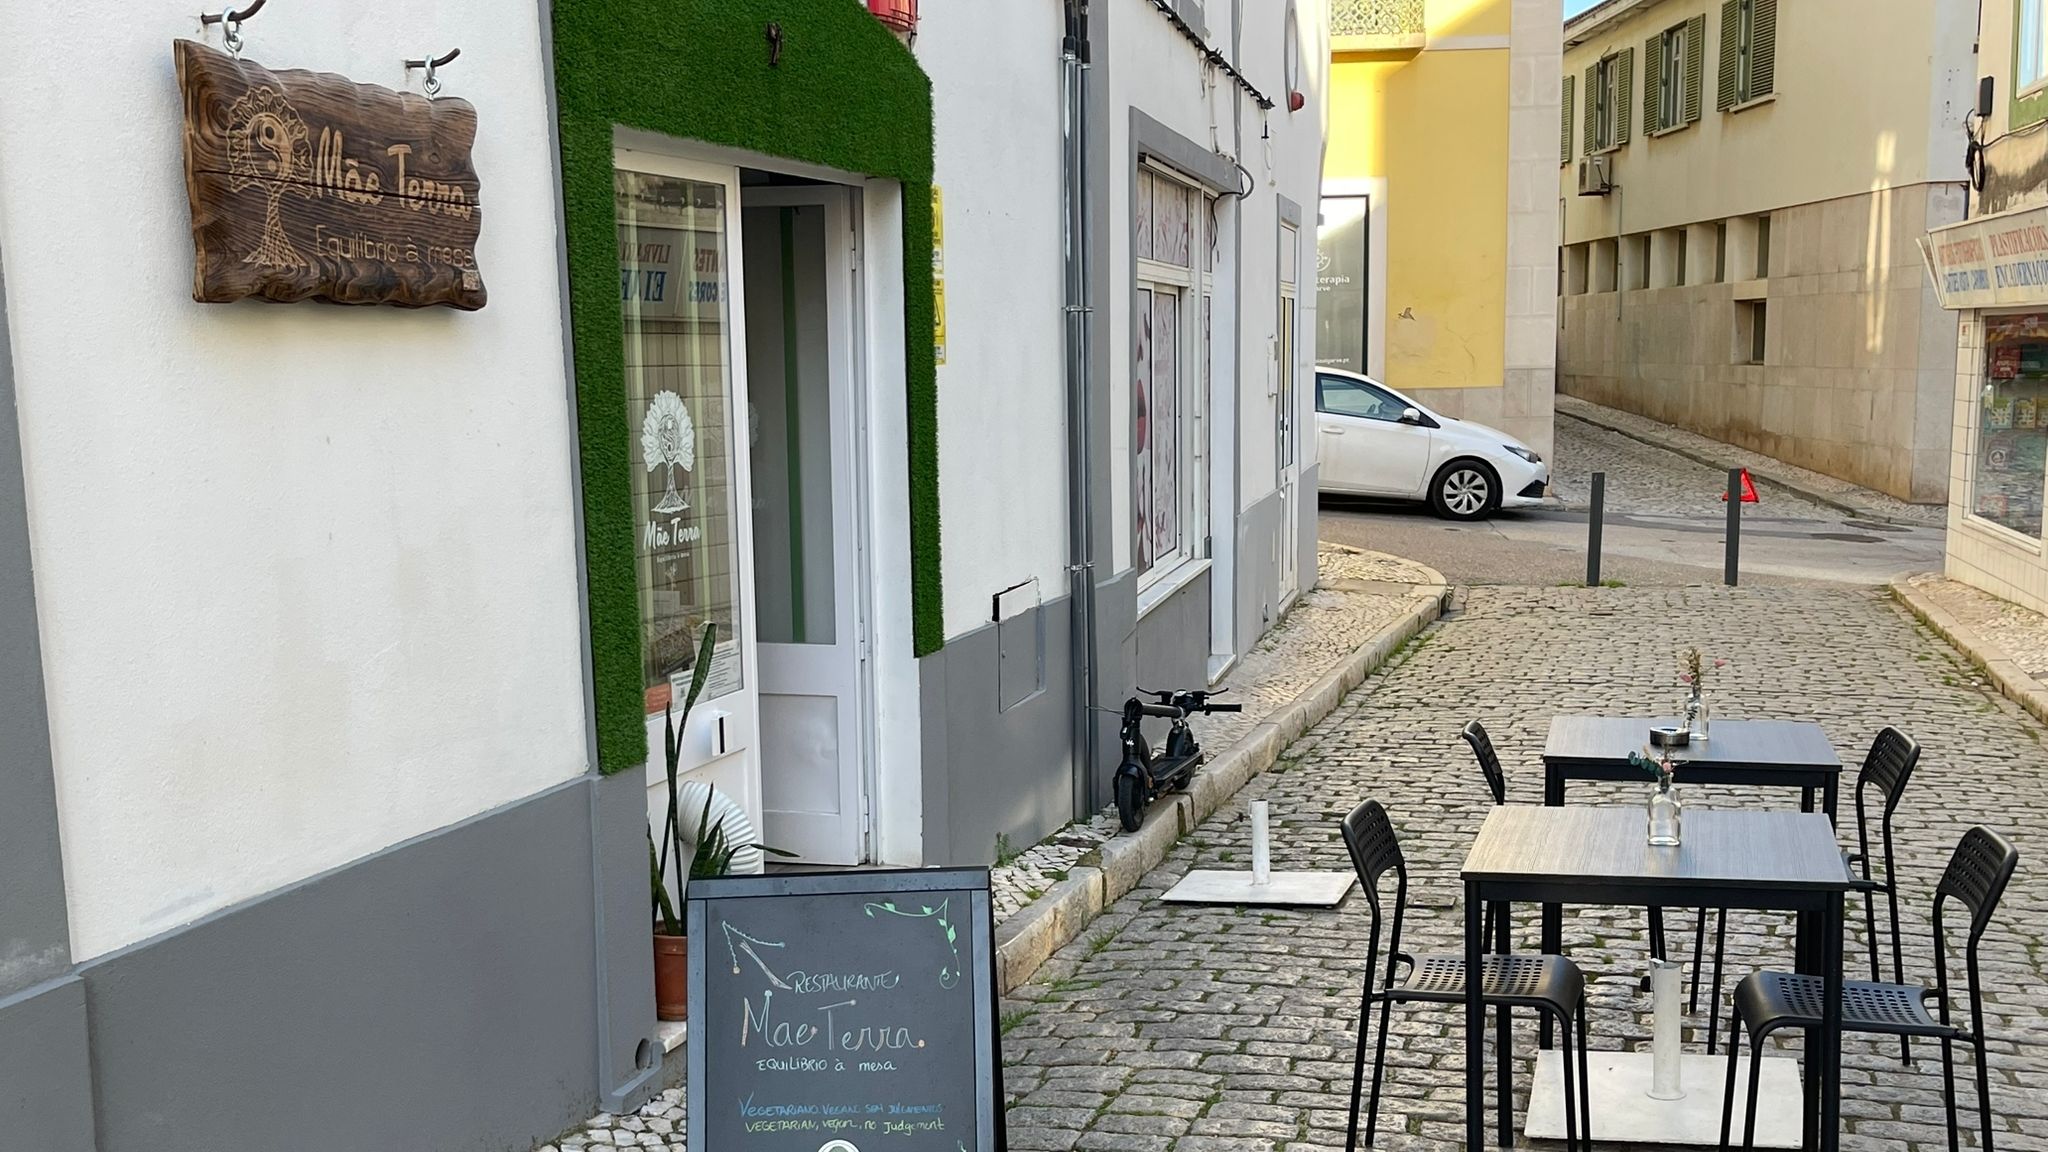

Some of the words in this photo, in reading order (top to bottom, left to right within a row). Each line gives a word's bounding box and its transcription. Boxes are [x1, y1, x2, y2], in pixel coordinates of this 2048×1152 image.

[387, 143, 473, 221] Terra
[406, 236, 420, 263] à
[428, 245, 475, 268] mesa
[1995, 258, 2048, 290] ENCADERNAÇÕ
[643, 520, 671, 550] Mãe
[670, 517, 701, 546] Terra
[786, 970, 900, 994] RESTAURANTE
[834, 1058, 846, 1072] à
[858, 1060, 897, 1072] mesa
[864, 1120, 877, 1130] no
